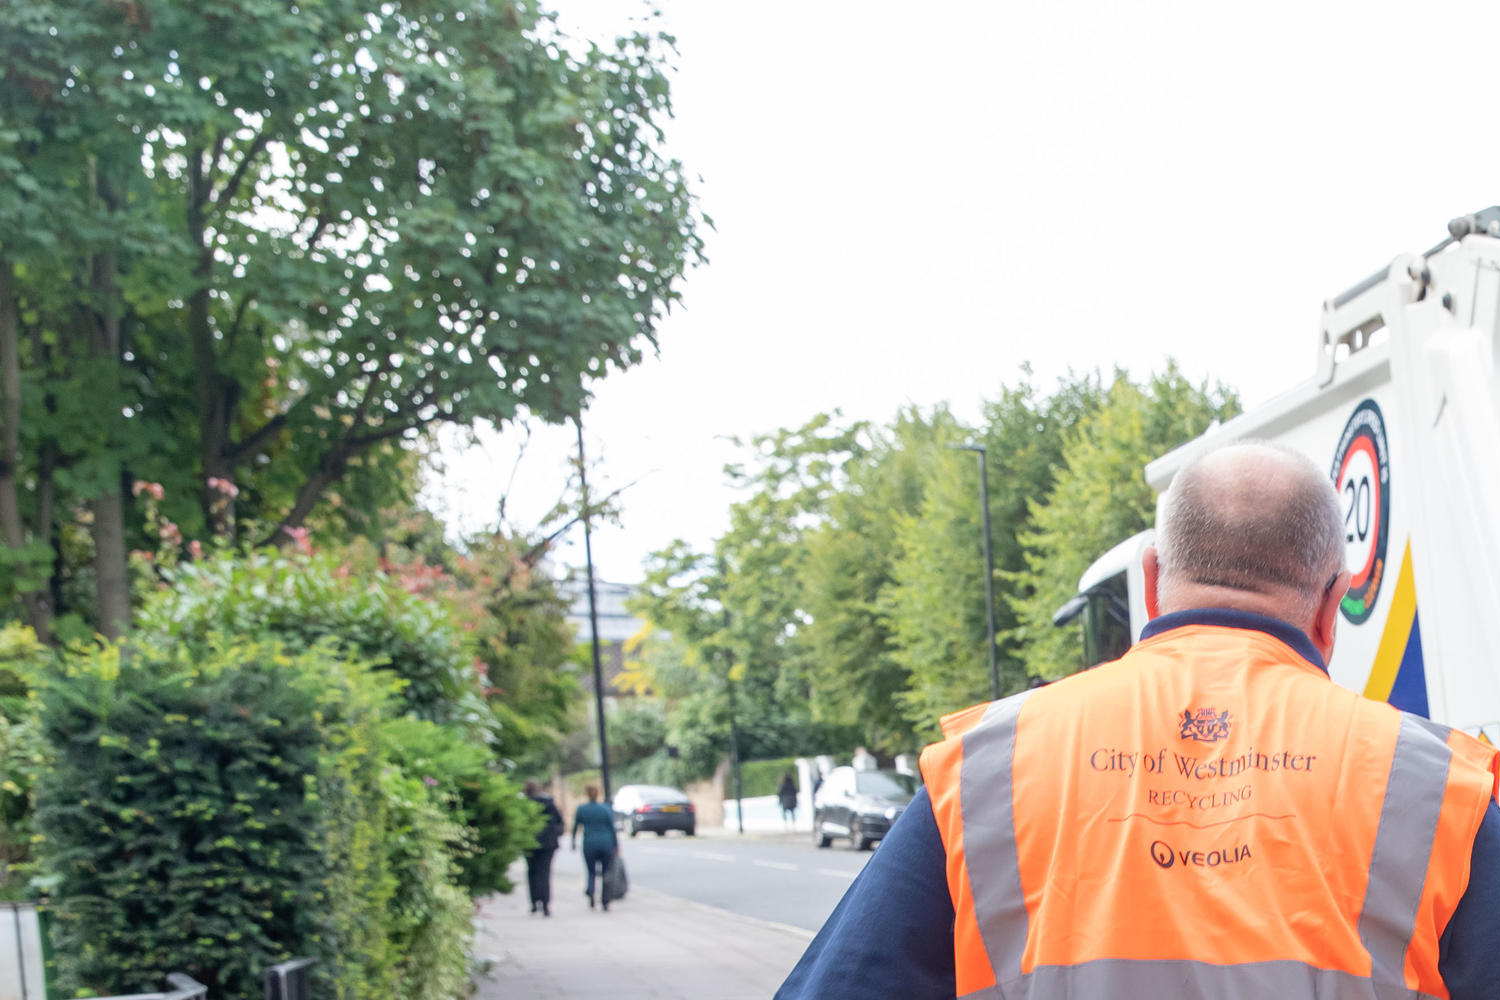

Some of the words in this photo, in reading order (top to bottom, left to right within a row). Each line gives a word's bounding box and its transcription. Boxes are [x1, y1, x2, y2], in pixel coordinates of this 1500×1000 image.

[1343, 475, 1370, 542] 20
[1091, 749, 1138, 778] City
[1143, 749, 1167, 773] of
[1174, 747, 1316, 780] Westminster
[1149, 785, 1252, 810] RECYCLING
[1179, 845, 1252, 866] VEOLIA
